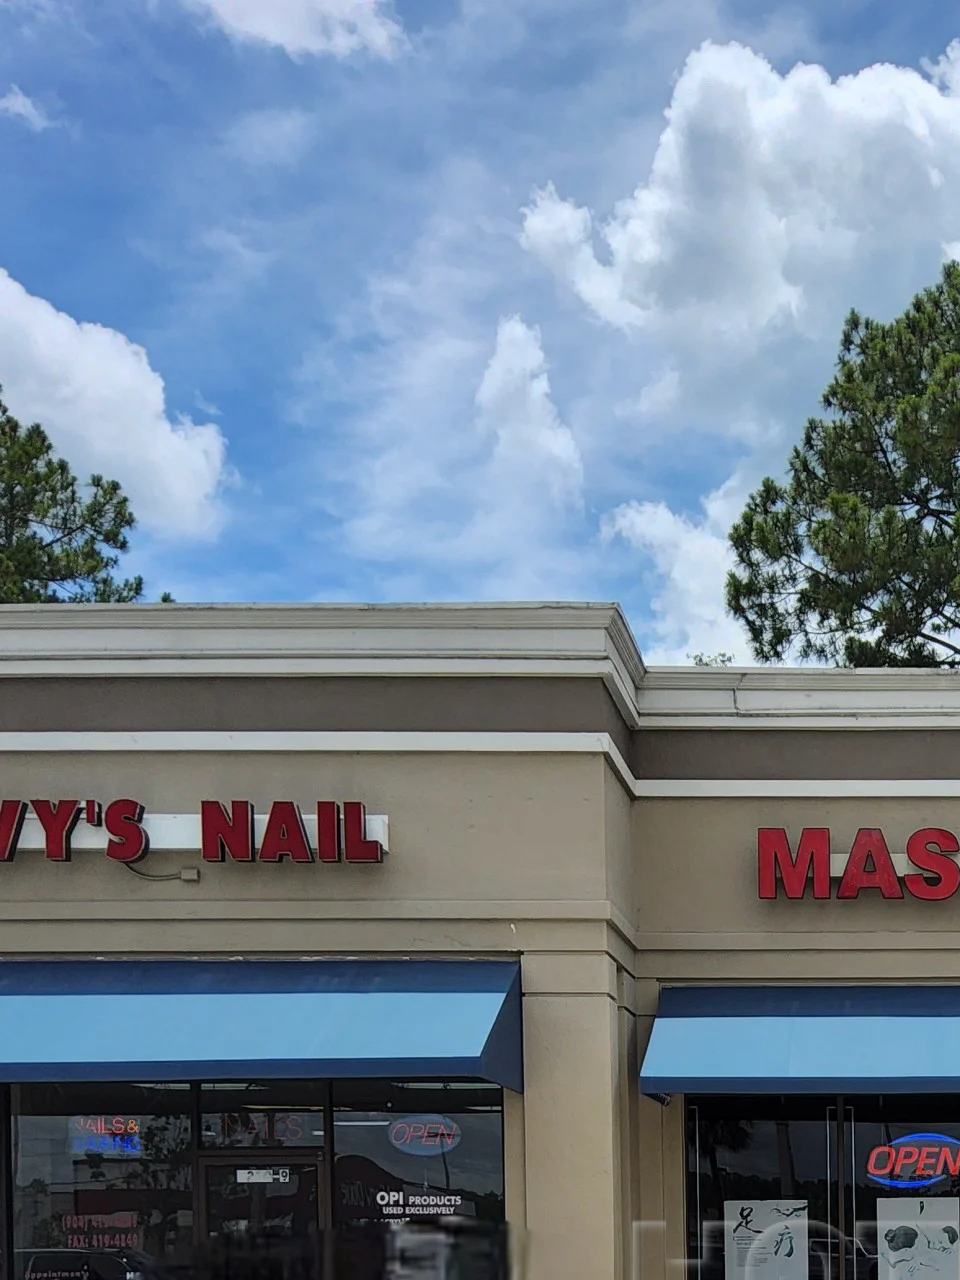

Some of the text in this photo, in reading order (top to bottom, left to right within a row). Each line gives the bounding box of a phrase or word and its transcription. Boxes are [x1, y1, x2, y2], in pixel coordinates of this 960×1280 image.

[201, 800, 384, 863] NAIL
[391, 1123, 457, 1145] OPEN
[376, 1191, 404, 1205] OPI
[408, 1195, 462, 1205] PRODUCTS
[382, 1206, 455, 1214] USED EXCLUSIVELY
[732, 1206, 764, 1234] 足
